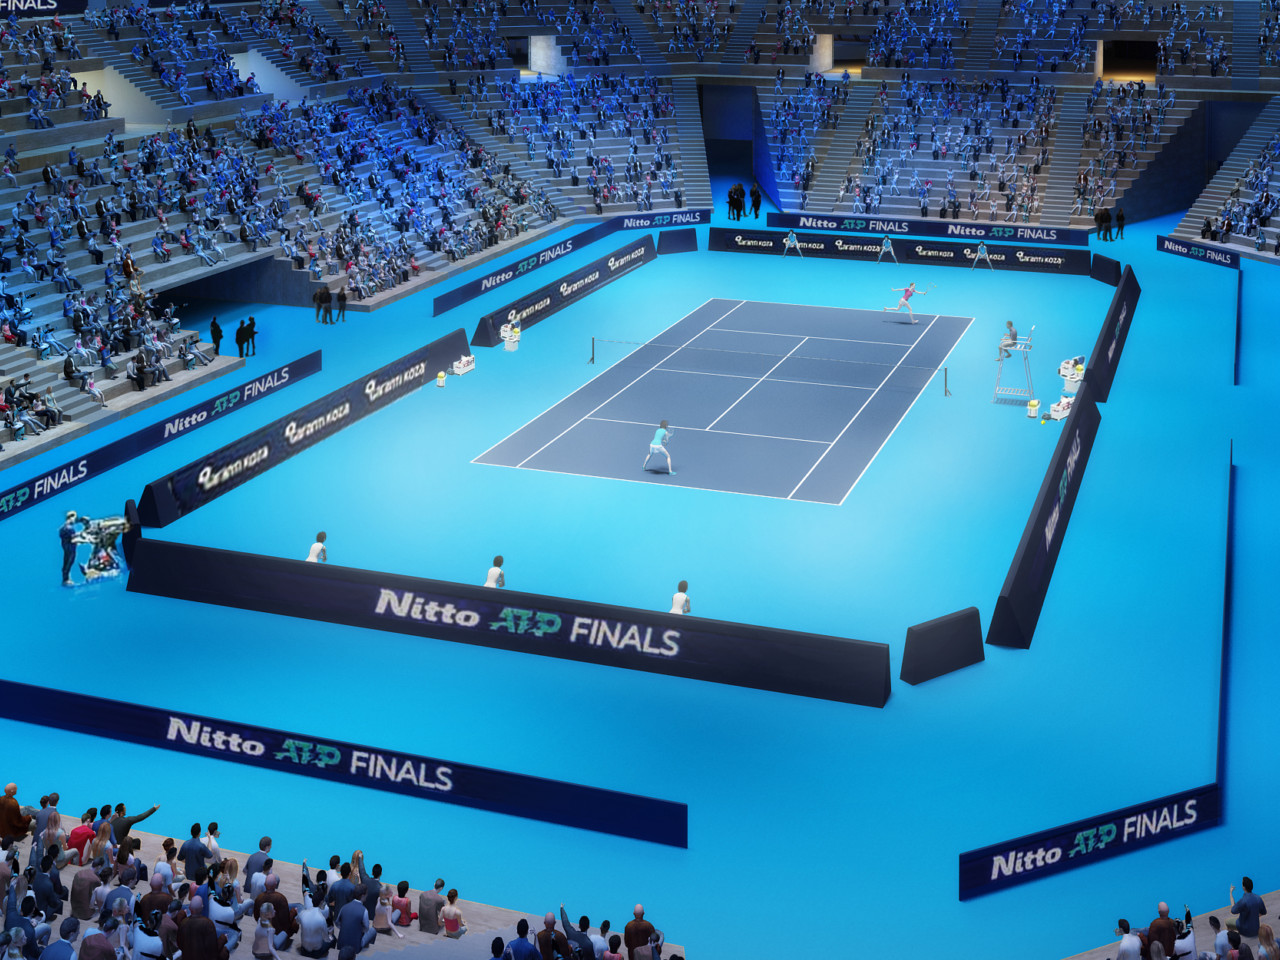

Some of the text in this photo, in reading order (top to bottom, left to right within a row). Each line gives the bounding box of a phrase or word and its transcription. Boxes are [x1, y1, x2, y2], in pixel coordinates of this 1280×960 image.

[624, 213, 701, 228] Nitto ATP FINALS
[799, 217, 909, 232] Nitto ATP FINALS
[947, 225, 1057, 240] Nitto ATP FINALS
[481, 241, 573, 290] Nitto ATP FINALS
[1164, 240, 1231, 263] Nitto ATP FINALS
[163, 367, 289, 438] Nitto ATP FINALS
[34, 460, 88, 499] FINALS
[375, 588, 681, 657] Nitto ATP FINALS
[166, 716, 453, 791] Nitto ATP FINALS
[991, 799, 1197, 881] Nitto ATP FINALS
